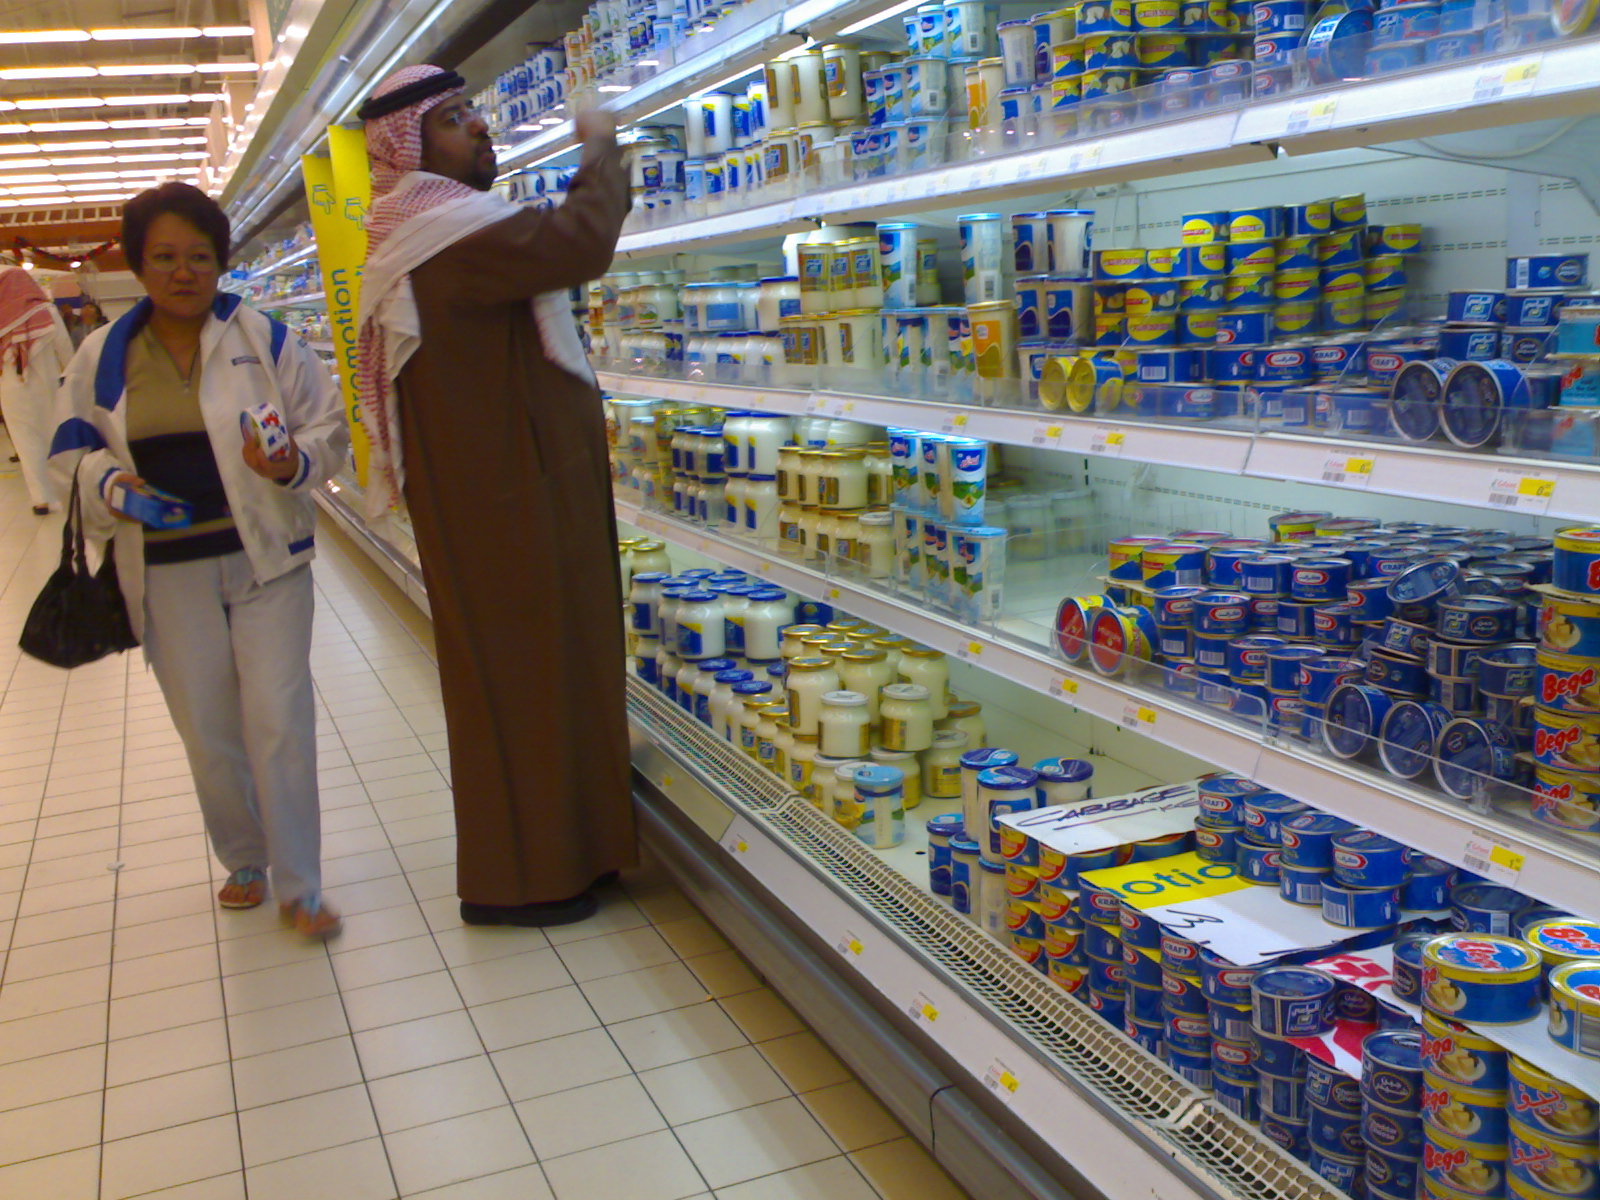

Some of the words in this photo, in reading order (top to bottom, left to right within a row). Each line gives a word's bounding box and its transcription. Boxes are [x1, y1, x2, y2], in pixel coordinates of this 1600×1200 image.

[1542, 667, 1595, 702] Bega
[1535, 726, 1581, 757] Bega
[1016, 785, 1196, 827] CABBAGE
[1101, 864, 1238, 898] otio
[1163, 942, 1189, 956] KRAFT
[1424, 1143, 1468, 1172] Bega
